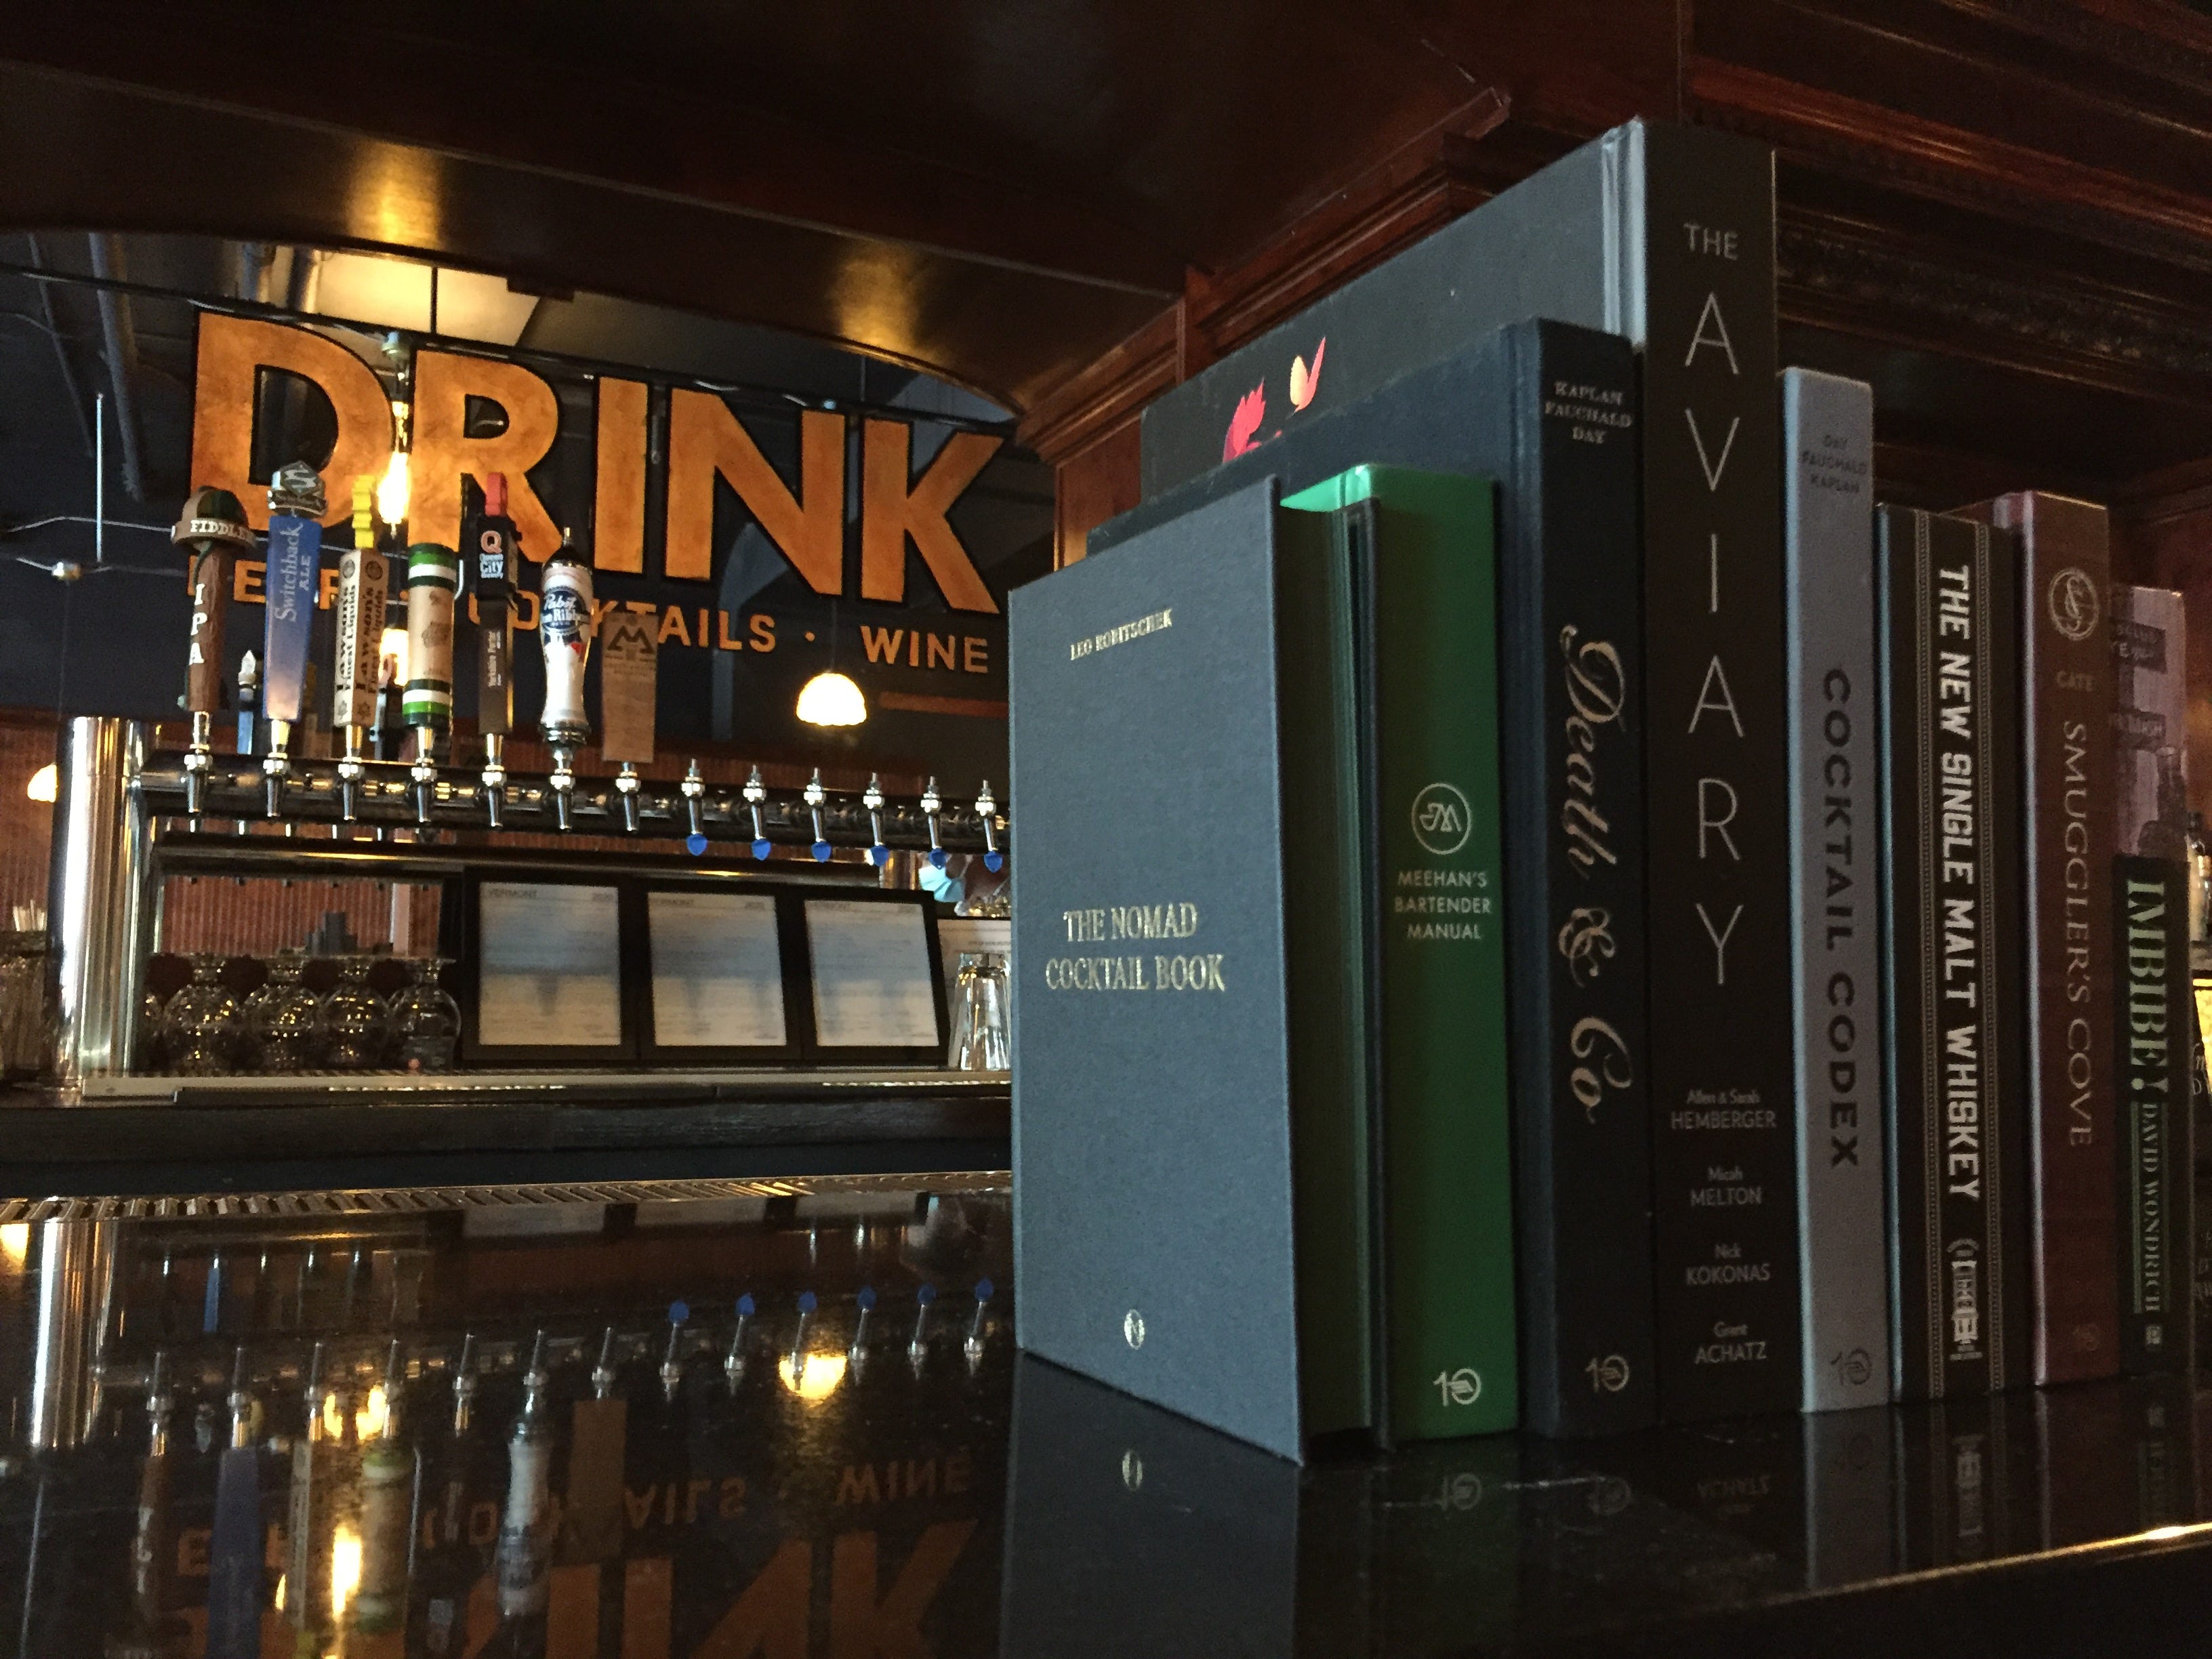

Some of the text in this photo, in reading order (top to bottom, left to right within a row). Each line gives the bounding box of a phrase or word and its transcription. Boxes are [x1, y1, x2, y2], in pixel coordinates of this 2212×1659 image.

[1683, 222, 1739, 261] THE
[191, 311, 1004, 615] DRINK
[273, 522, 304, 622] Switchback
[480, 560, 504, 574] City
[544, 592, 576, 613] Pabst
[187, 583, 207, 665] IPA
[860, 625, 989, 674] WINE
[1070, 638, 1093, 661] LEO
[1561, 623, 1627, 881] Death
[1397, 870, 1489, 889] MEEHAN'S
[1939, 565, 1981, 1204] THE NEW SINGLE MALT WHISKEY
[1063, 902, 1198, 942] THE NOMAD
[1393, 896, 1492, 915] BARTENDER
[1823, 668, 1859, 1168] COCKTAIL CODEX
[1406, 922, 1483, 941] MANUAL
[2064, 719, 2093, 1147] SMUGGLER'S COVE
[1045, 954, 1226, 992] COCKTAIL BOOK
[2127, 879, 2169, 1094] IMBIBE!
[1670, 1109, 1777, 1130] HEMBERGER
[2141, 1102, 2159, 1174] DAVID
[1689, 1187, 1763, 1208] MELTON
[1714, 1242, 1742, 1259] Nick
[1685, 1263, 1771, 1286] KOKONAS
[1713, 1321, 1748, 1338] Grant
[1694, 1340, 1767, 1366] ACHATZ
